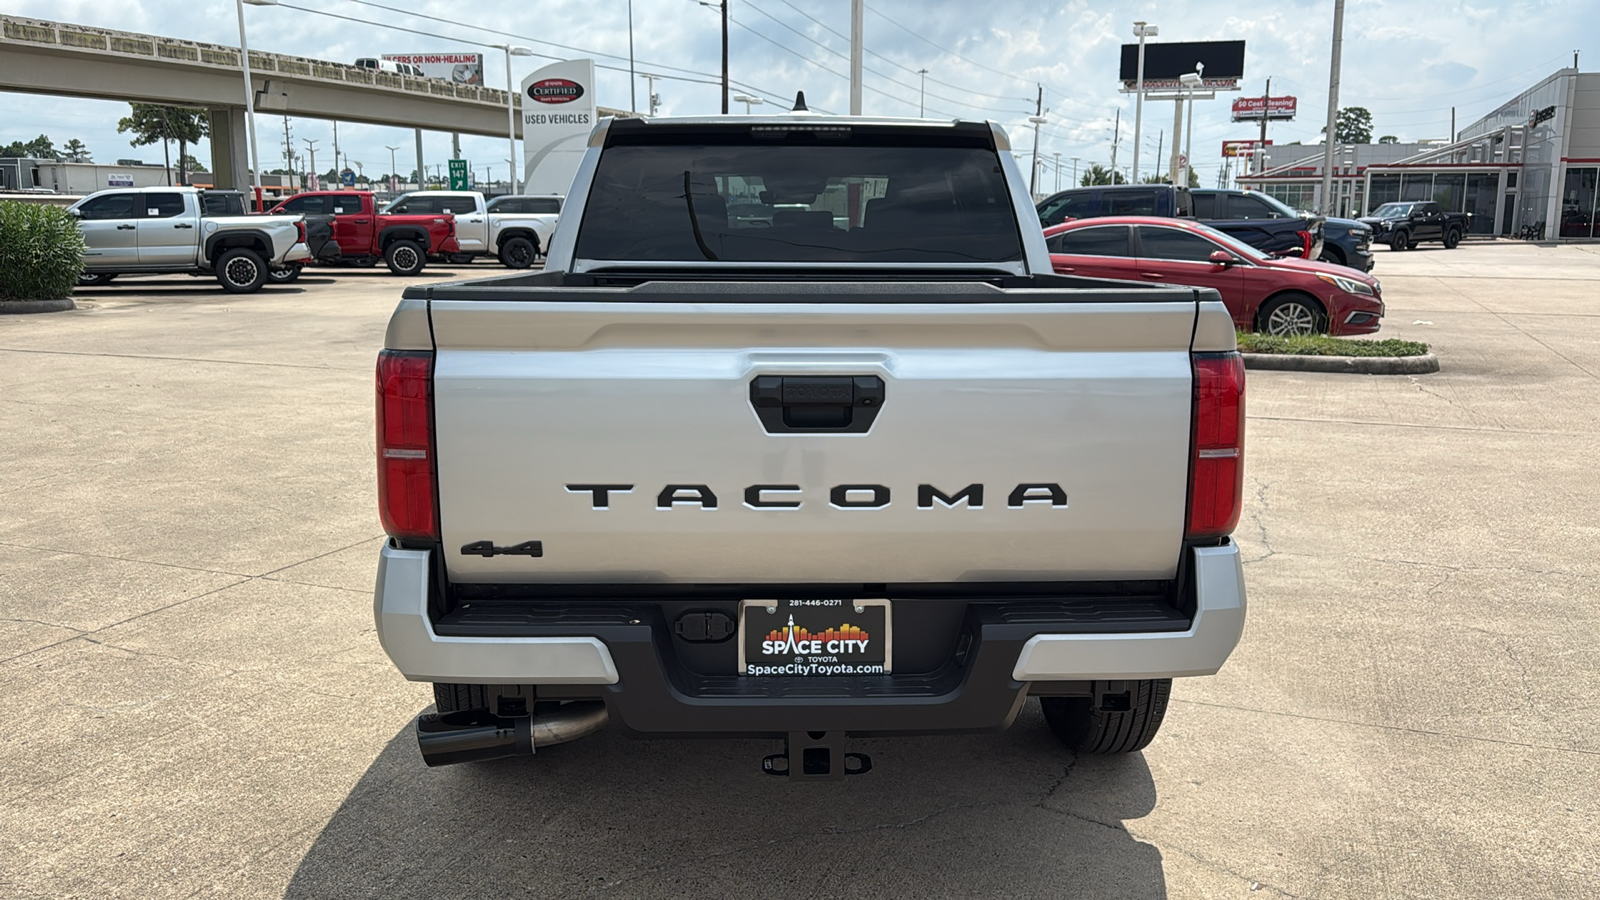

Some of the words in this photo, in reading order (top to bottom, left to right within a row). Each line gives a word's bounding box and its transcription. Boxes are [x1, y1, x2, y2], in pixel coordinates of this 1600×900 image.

[413, 55, 424, 64] OR
[425, 54, 476, 64] NON-HEALING
[533, 87, 576, 96] CERTIFIED
[1248, 100, 1263, 108] Cost
[525, 114, 546, 125] USED
[548, 114, 589, 125] VEHICLES
[452, 170, 465, 178] 147
[786, 386, 850, 398] TOYOTA
[565, 483, 1070, 510] TACOMA
[789, 599, 843, 607] 281-446-0271
[762, 639, 822, 655] SPACE
[826, 639, 869, 654] CITY
[747, 664, 884, 676] SpaceCityToyota.com
